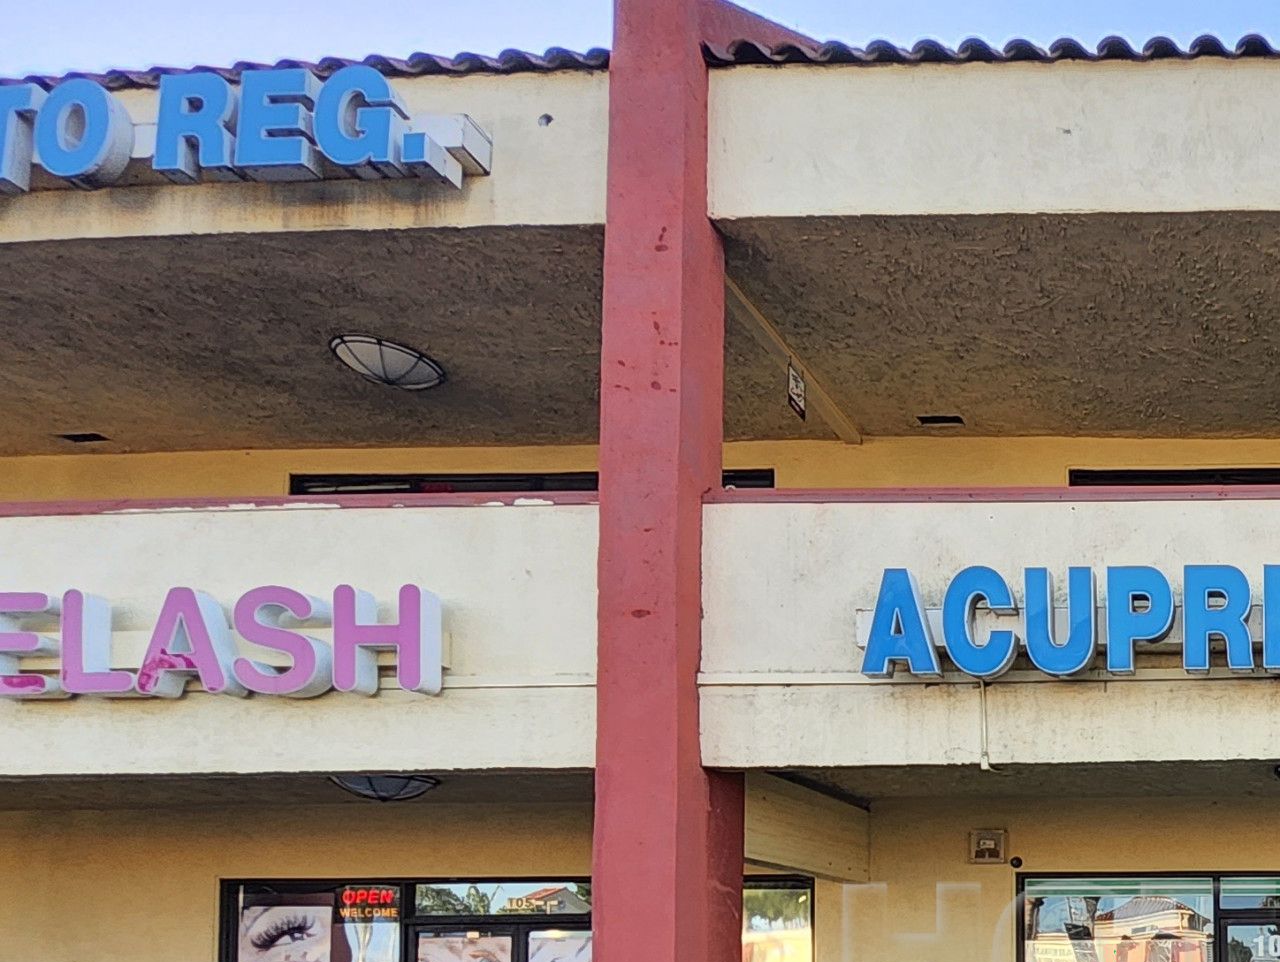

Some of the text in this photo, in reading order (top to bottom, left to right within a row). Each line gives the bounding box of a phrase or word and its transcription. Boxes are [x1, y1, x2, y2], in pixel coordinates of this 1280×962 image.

[153, 65, 427, 171] REG.
[342, 888, 395, 905] OPEN
[508, 897, 533, 909] 105
[339, 907, 399, 918] WELCOME
